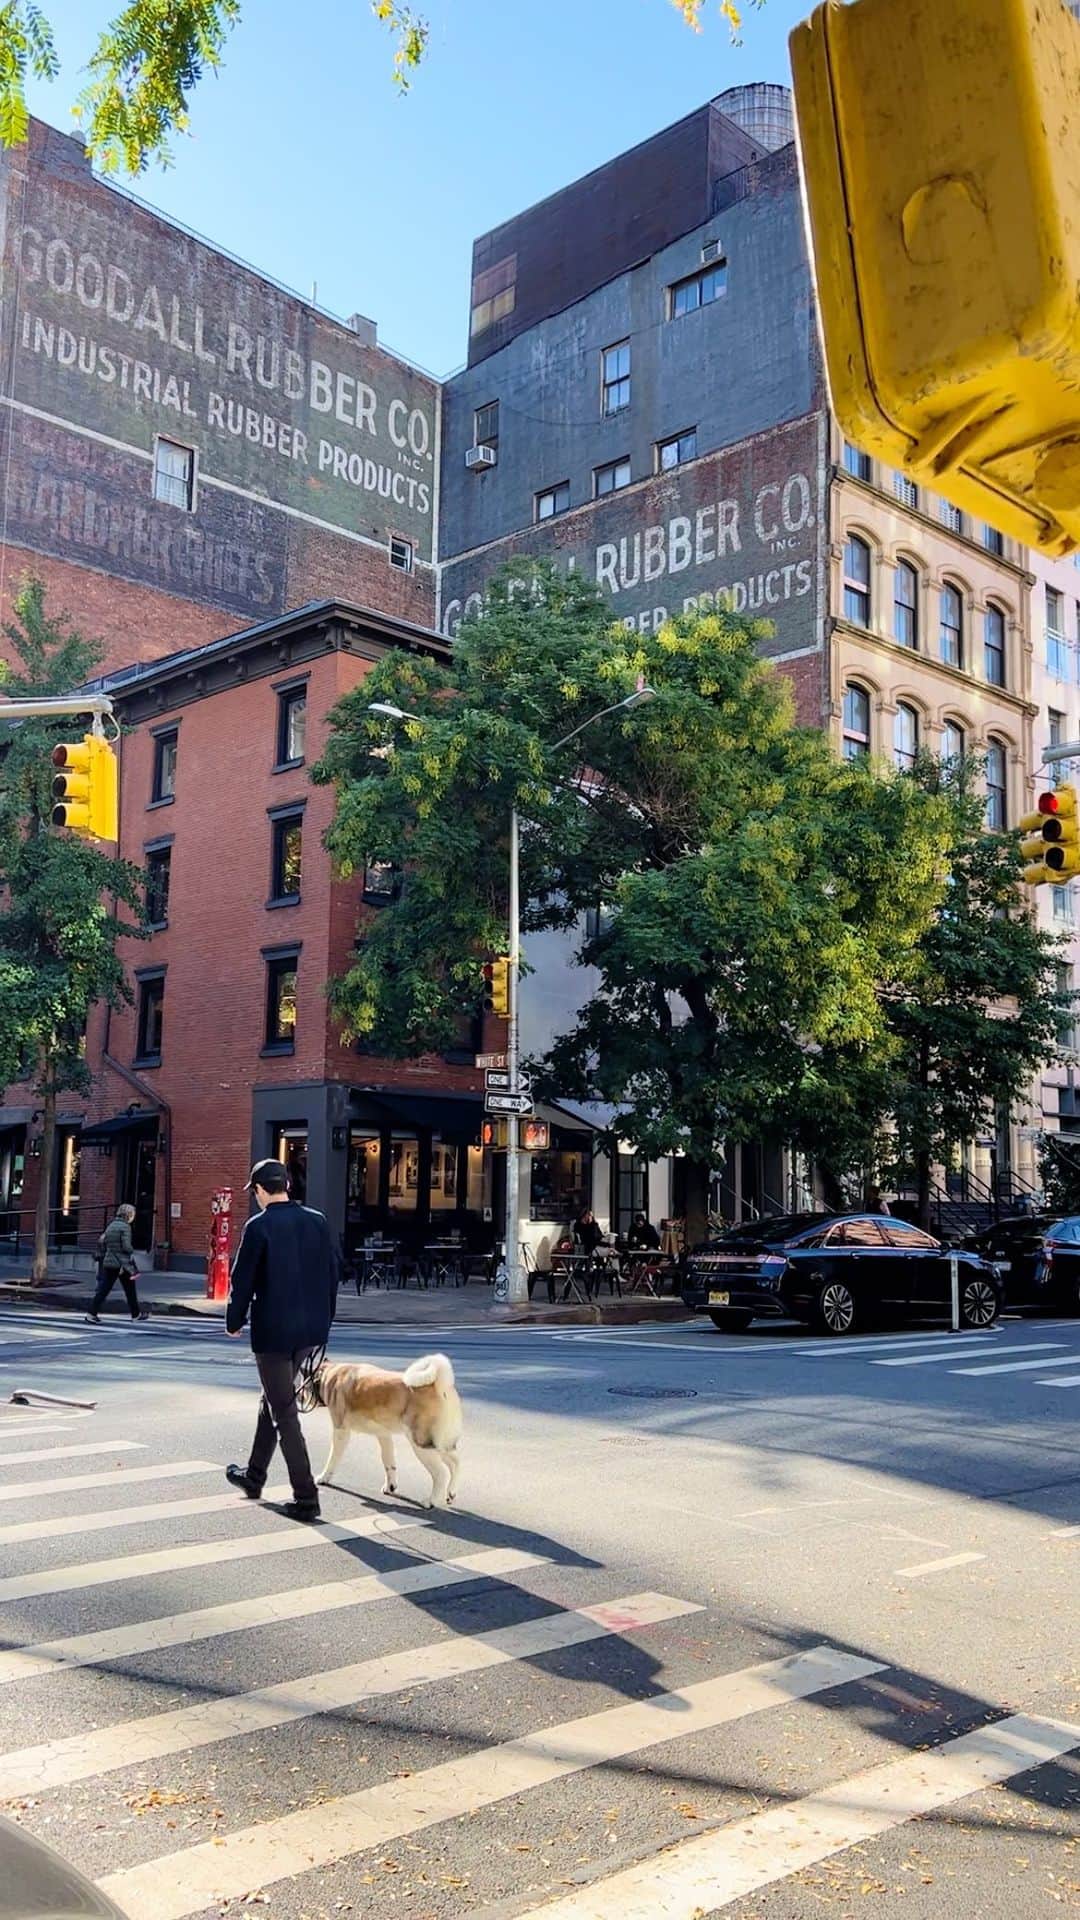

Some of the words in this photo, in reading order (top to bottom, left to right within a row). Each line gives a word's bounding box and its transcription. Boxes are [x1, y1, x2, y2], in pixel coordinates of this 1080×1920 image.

[13, 225, 216, 363] GOODALL
[227, 320, 377, 436] RUBBER
[388, 399, 433, 462] CO.
[21, 312, 197, 418] INDUSTRIAL
[208, 391, 309, 465] RUBBER
[319, 440, 430, 515] PRODUCTS
[398, 451, 424, 472] INC.
[596, 498, 742, 595] RUBBER
[753, 472, 816, 541] CO.
[770, 537, 802, 555] INC.
[490, 1075, 503, 1084] ONE
[490, 1097, 503, 1106] ONE
[511, 1099, 528, 1108] WAY
